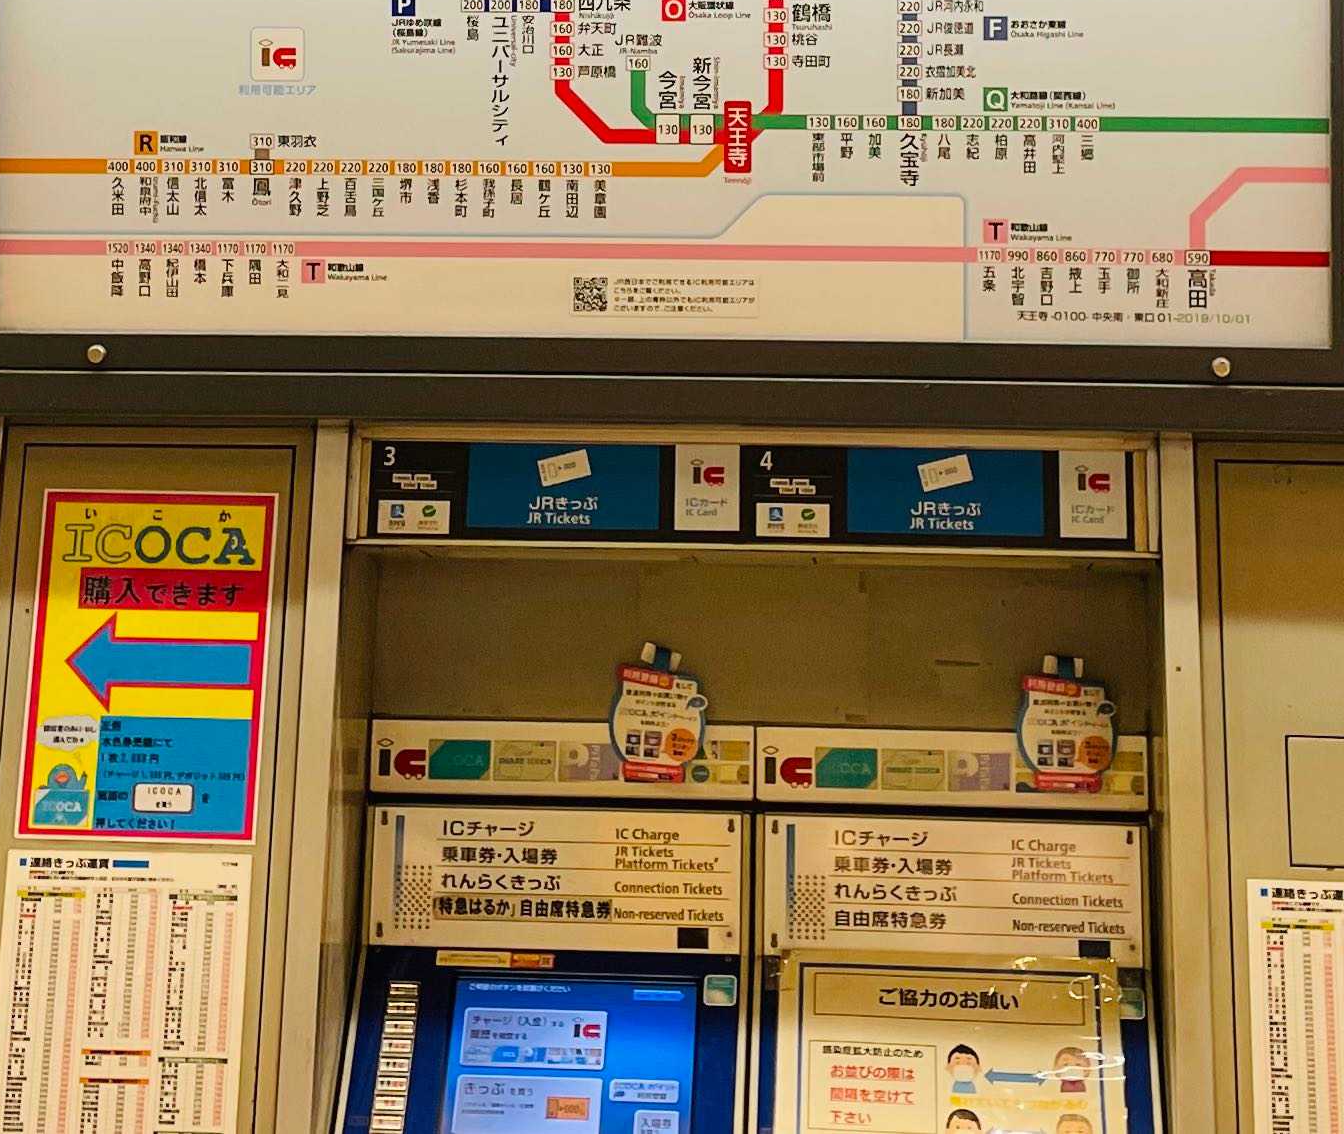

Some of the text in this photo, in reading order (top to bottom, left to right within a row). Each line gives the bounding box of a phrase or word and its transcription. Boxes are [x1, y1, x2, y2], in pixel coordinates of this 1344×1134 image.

[791, 3, 833, 24] 鶴橋
[578, 44, 604, 56] 大正
[791, 54, 831, 68] 寺田町
[492, 17, 510, 147] ユニバーサルシティ
[659, 71, 678, 109] 今宮
[693, 57, 711, 109] 新今宮
[728, 107, 748, 167] 天王寺
[900, 133, 919, 186] 久宝寺
[1188, 269, 1207, 309] 高田
[383, 446, 396, 467] 3
[759, 451, 773, 471] 4
[529, 496, 599, 511] JRきっぷ
[911, 501, 981, 517] JRきっぷ
[527, 512, 591, 525] JR Tickets
[910, 517, 974, 531] JR Tickets
[62, 522, 256, 566] ICOCA
[83, 576, 243, 606] 購入できます
[442, 820, 535, 837] ICチャージ
[616, 829, 680, 843] IC Charge
[834, 830, 929, 847] ICチャージ
[441, 847, 558, 865] 乗車券・入場券
[615, 846, 674, 859] JR Tickets
[834, 857, 953, 876] 乗車券・入場券
[441, 873, 561, 891] れんらくきっぷ
[614, 881, 723, 896] Connection Tickets
[834, 883, 957, 902] れんらくきっぷ
[614, 908, 724, 923] Non-reserved Tickets
[834, 910, 947, 930] 自由席特急券
[878, 987, 1020, 1011] ご協力のお願い
